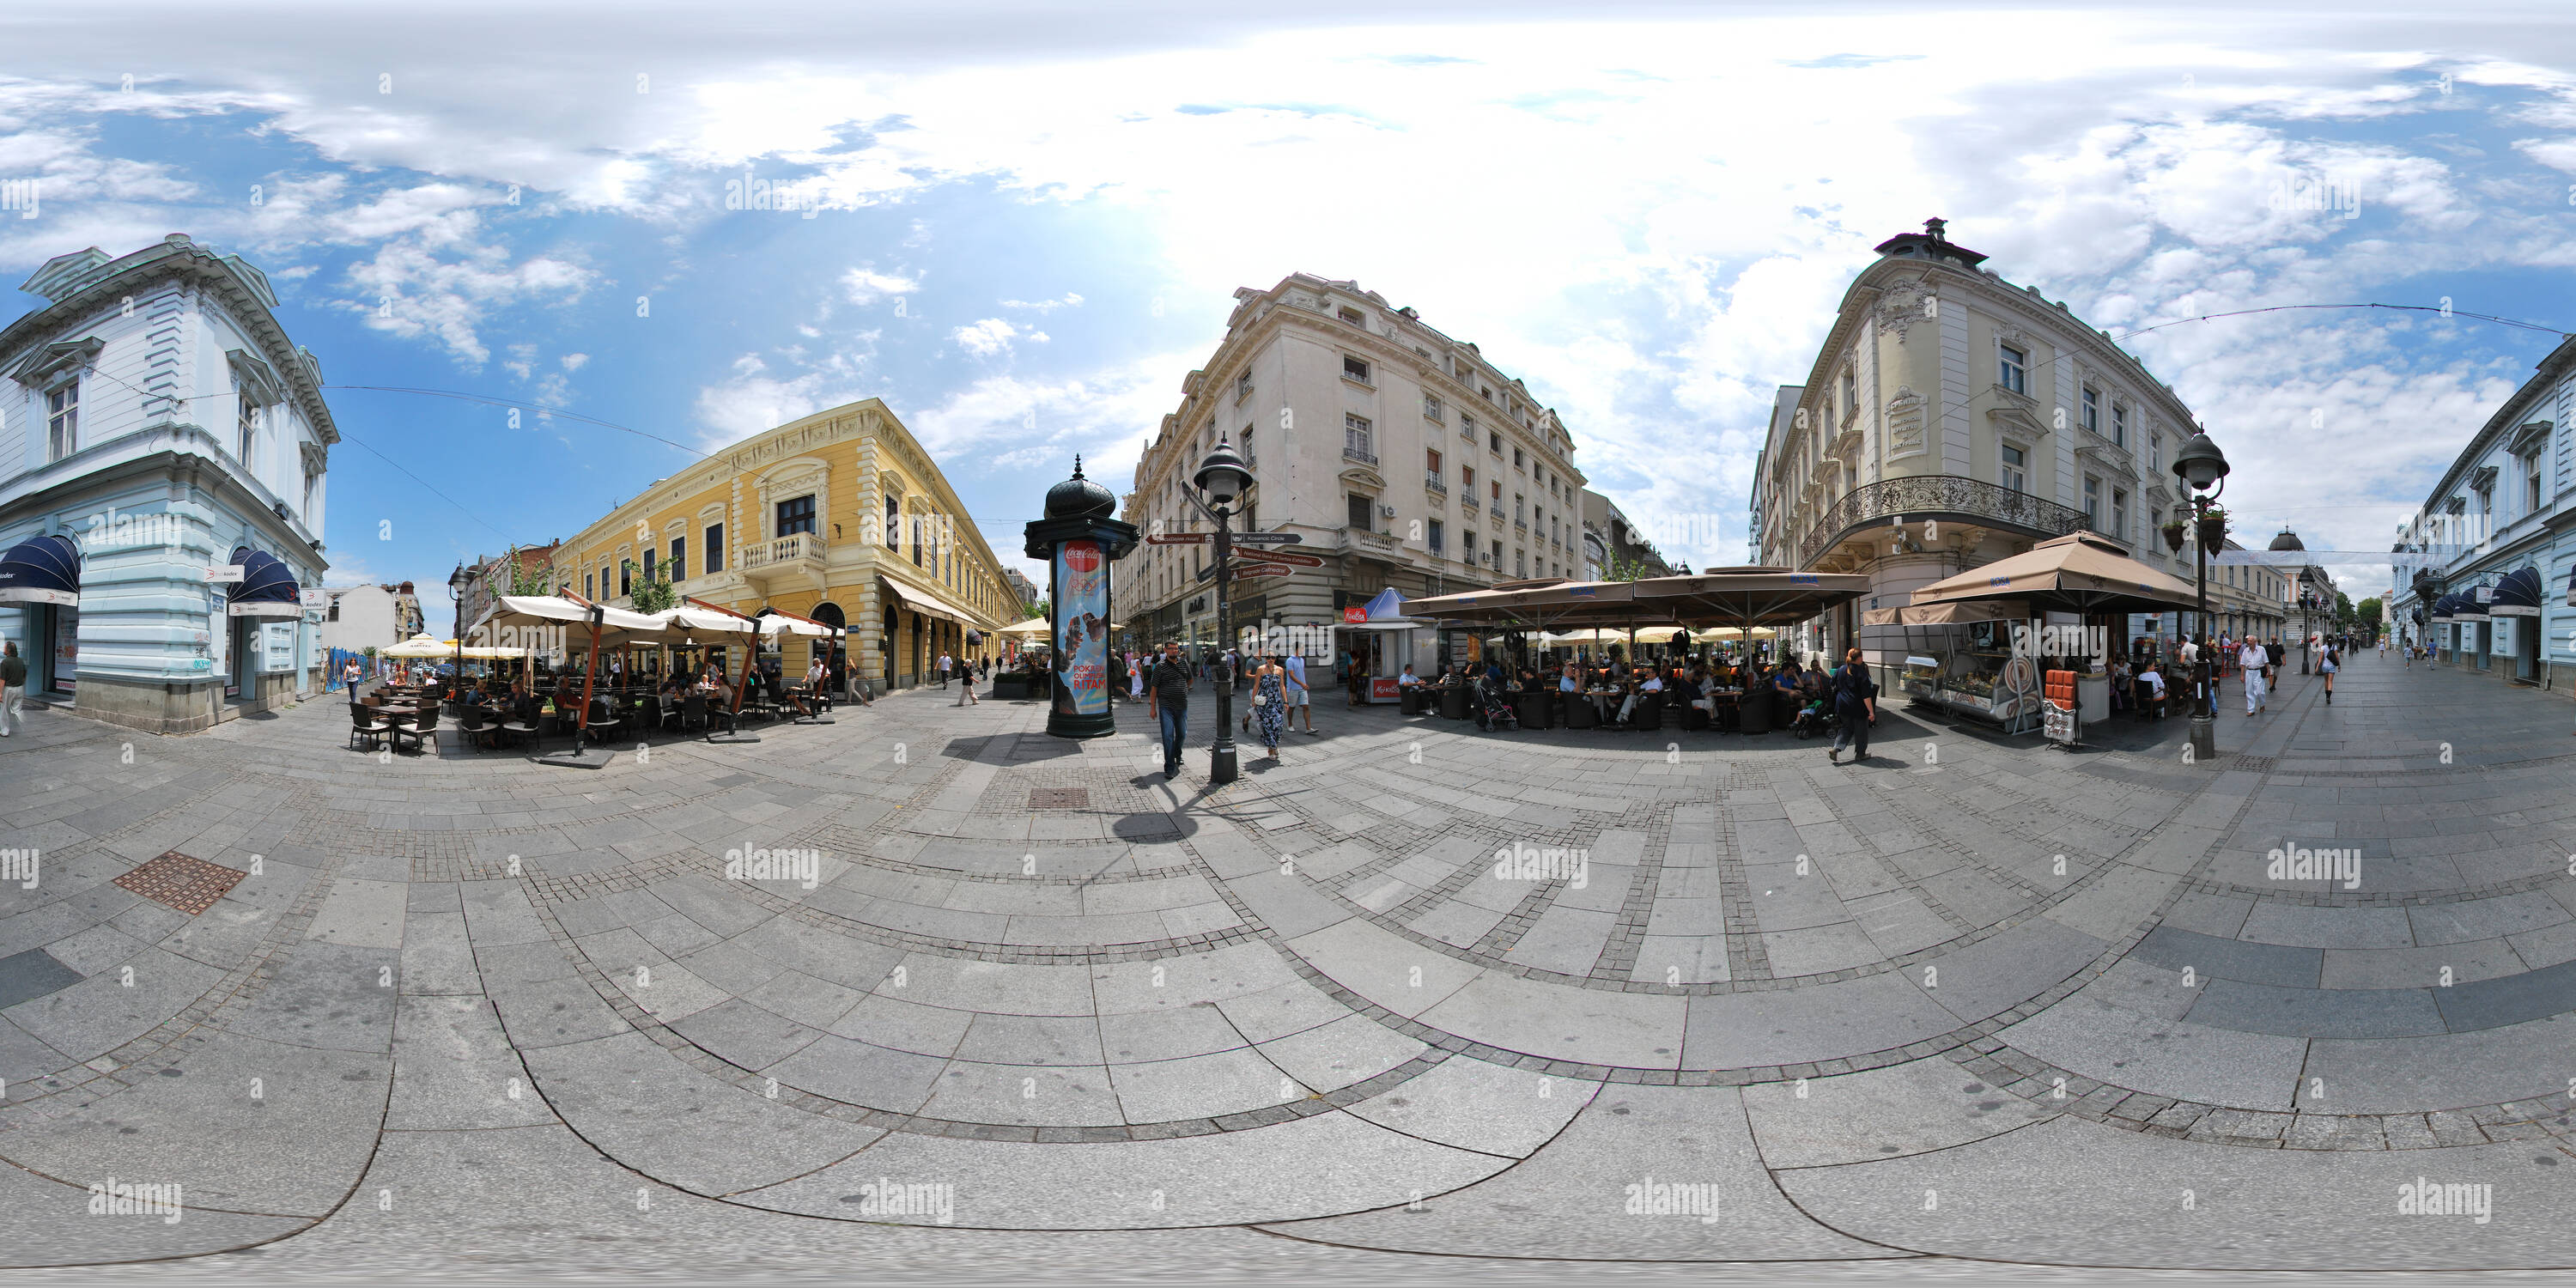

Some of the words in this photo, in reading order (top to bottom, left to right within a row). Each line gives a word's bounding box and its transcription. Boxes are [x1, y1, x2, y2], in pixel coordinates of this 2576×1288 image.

[1790, 574, 1819, 585] ROSA
[1990, 577, 2011, 586] ROSA
[1570, 586, 1596, 596] ROSA
[1073, 679, 1106, 690] RITAM
